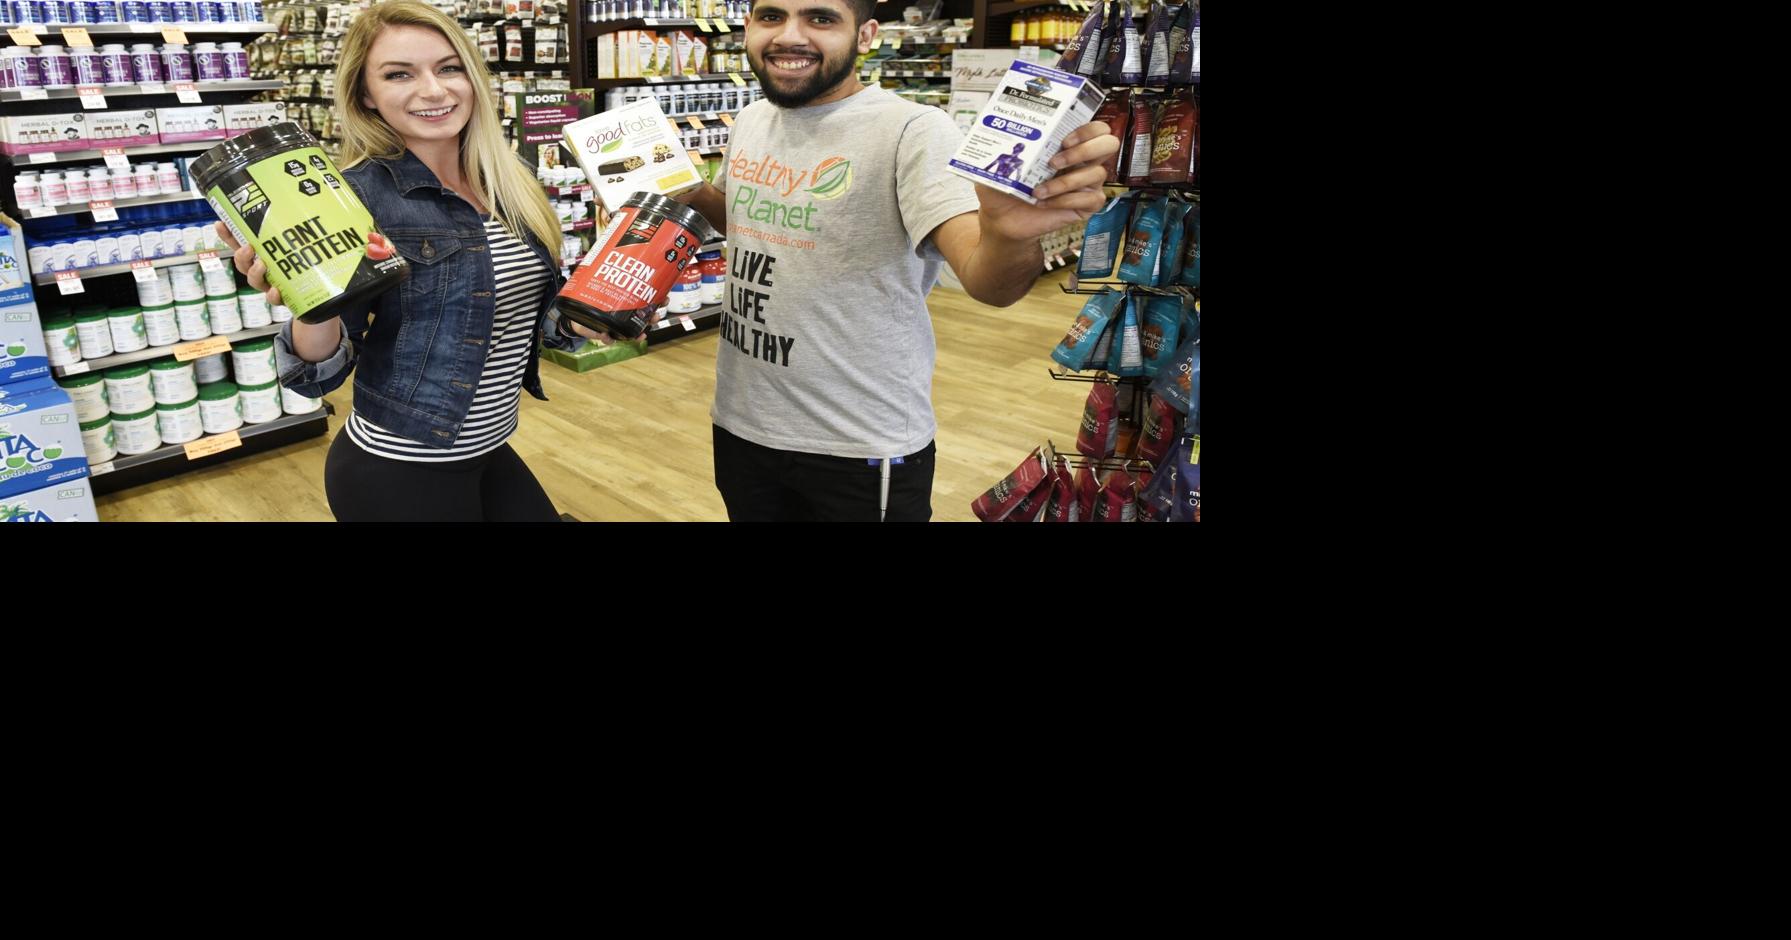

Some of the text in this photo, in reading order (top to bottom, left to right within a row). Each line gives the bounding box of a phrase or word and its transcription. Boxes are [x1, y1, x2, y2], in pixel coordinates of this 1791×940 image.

[991, 117, 1007, 129] 50
[1006, 121, 1034, 135] BILLION
[993, 105, 1010, 115] Once
[1010, 109, 1026, 120] Daily
[262, 216, 328, 261] PLANT
[277, 227, 365, 280] PROTEIN
[594, 263, 658, 304] PROTEIN
[604, 250, 656, 283] CLEAN
[720, 310, 795, 367] HEALTHY
